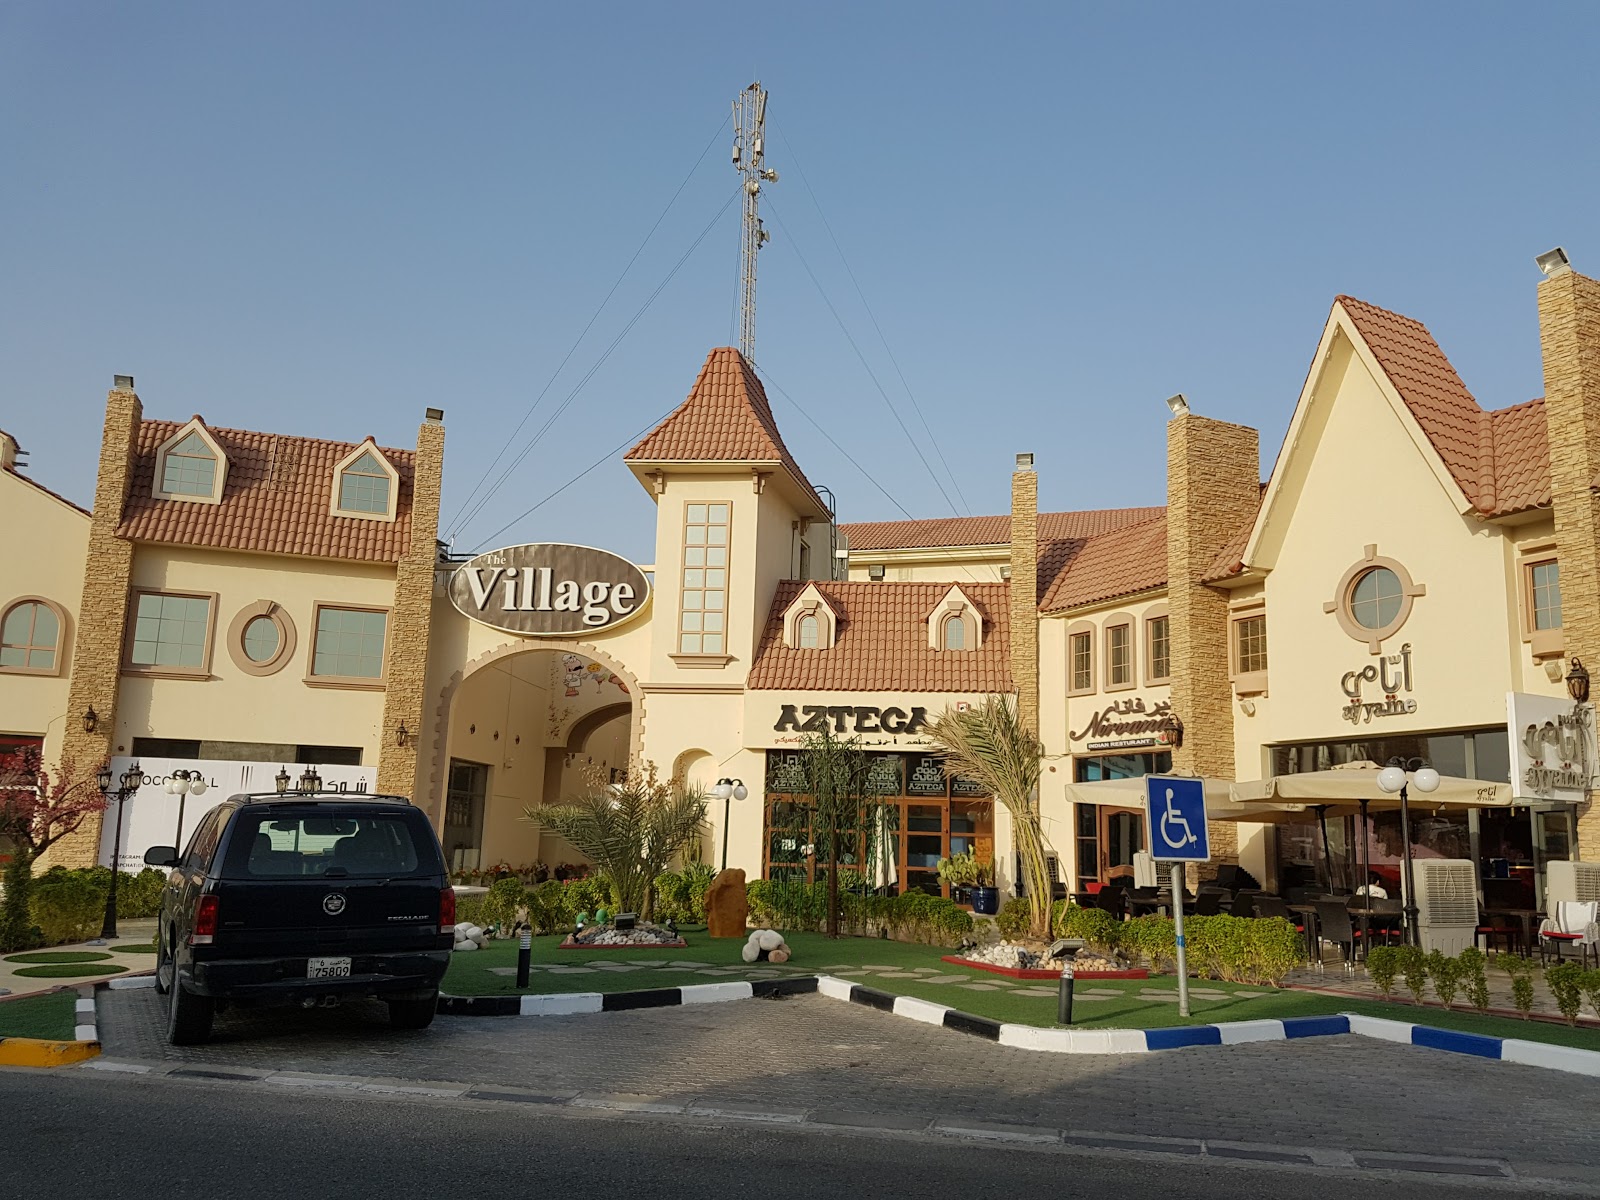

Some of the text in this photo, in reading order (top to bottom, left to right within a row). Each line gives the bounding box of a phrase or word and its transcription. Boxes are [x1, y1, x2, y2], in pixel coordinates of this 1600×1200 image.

[486, 554, 507, 565] The
[462, 566, 635, 626] Village
[1070, 706, 1172, 741] Nirvana
[1110, 738, 1150, 747] RESTURANT
[315, 966, 350, 978] 75809
